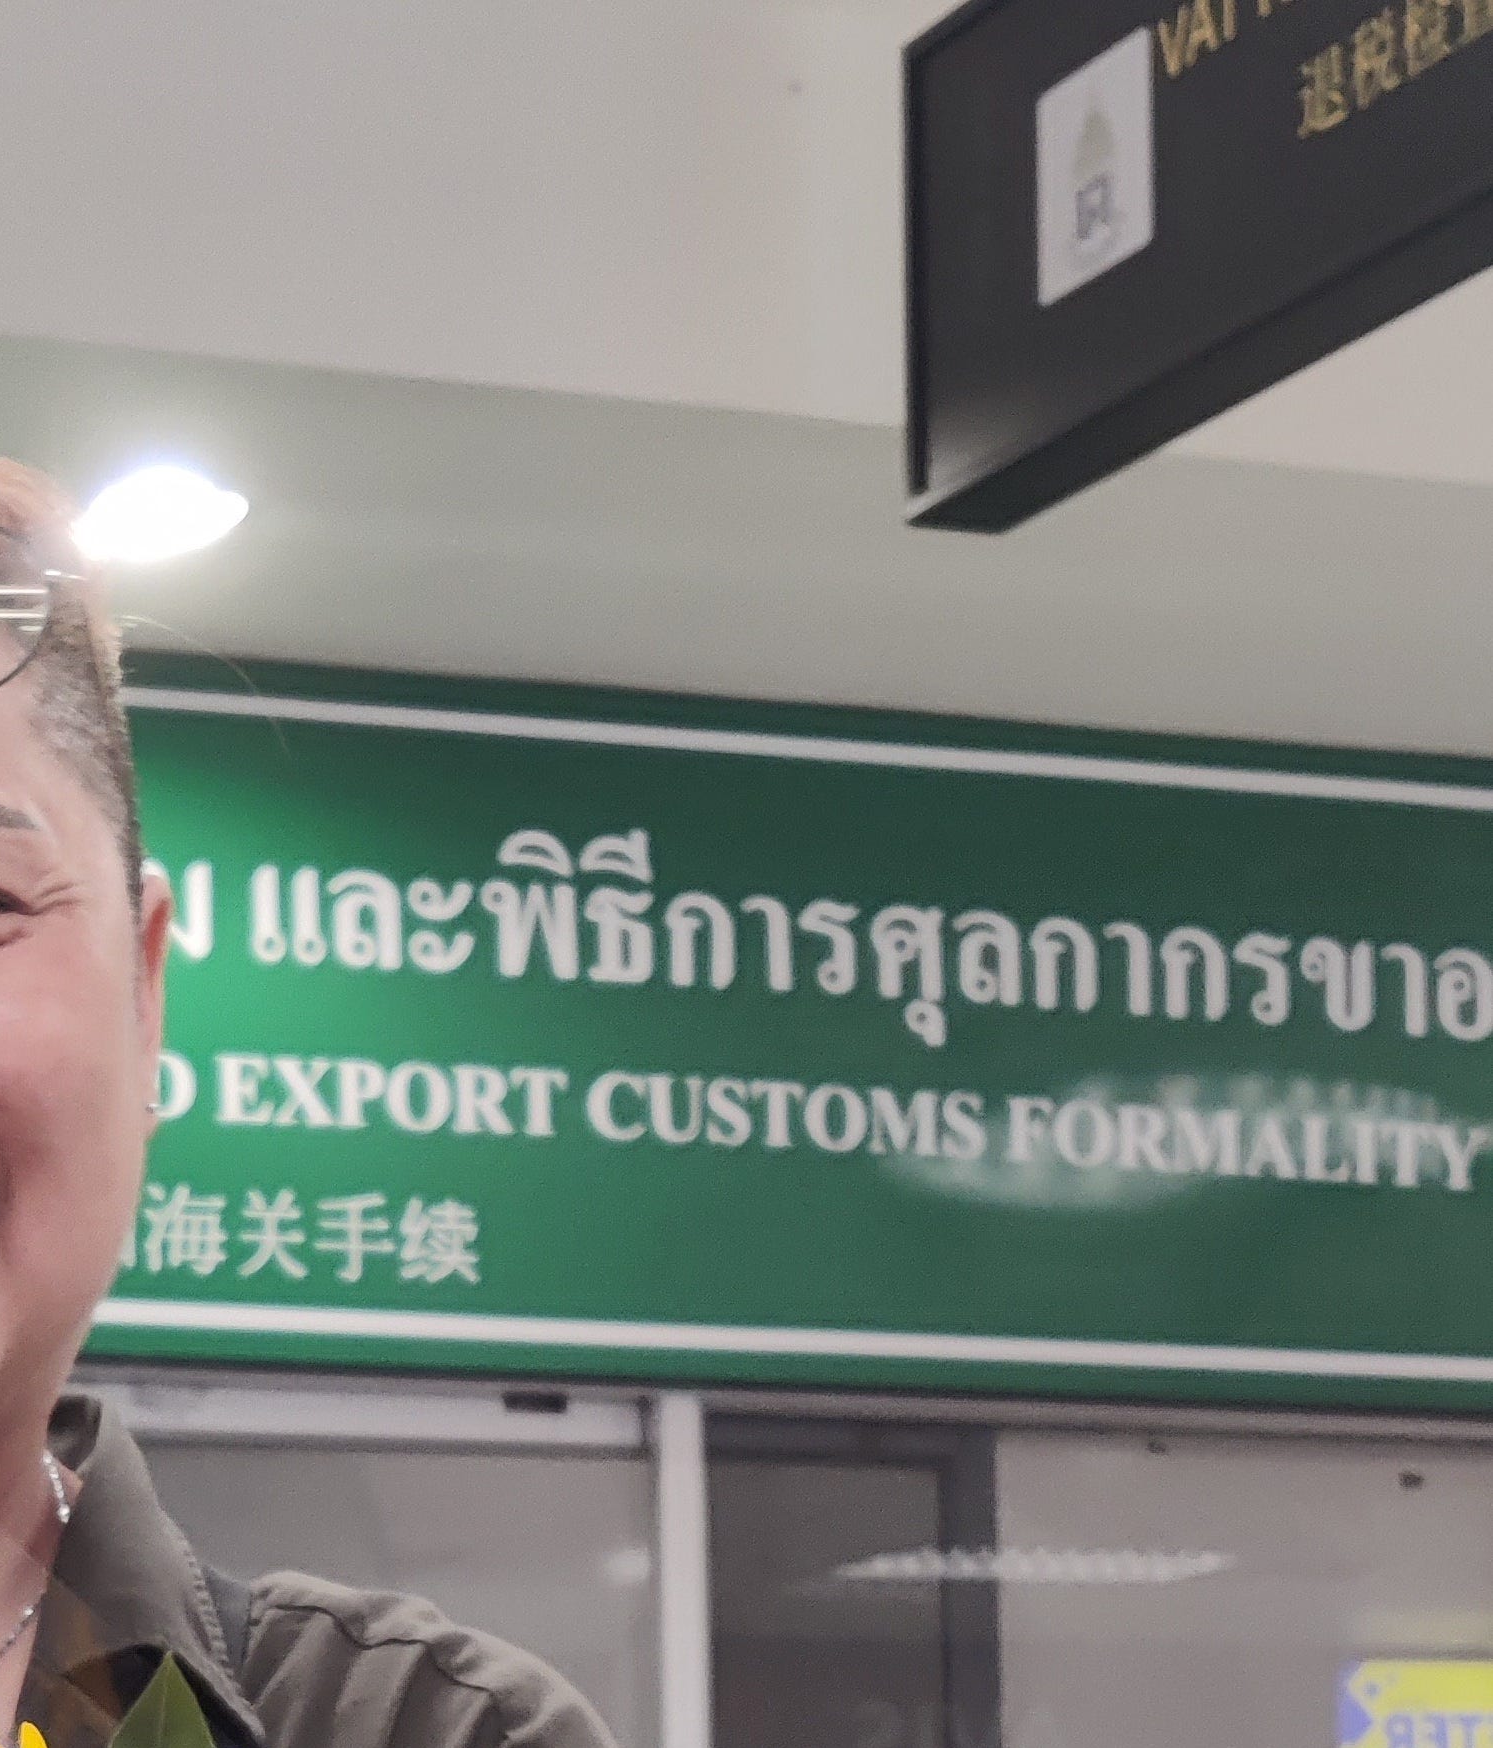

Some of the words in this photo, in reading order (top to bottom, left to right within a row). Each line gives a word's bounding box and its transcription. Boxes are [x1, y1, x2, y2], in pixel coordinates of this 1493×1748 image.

[215, 1050, 568, 1138] EXPORT
[586, 1069, 987, 1162] CUSTOMS
[1008, 1097, 1489, 1192] FORMALITY
[119, 1180, 482, 1285] 海关手续
